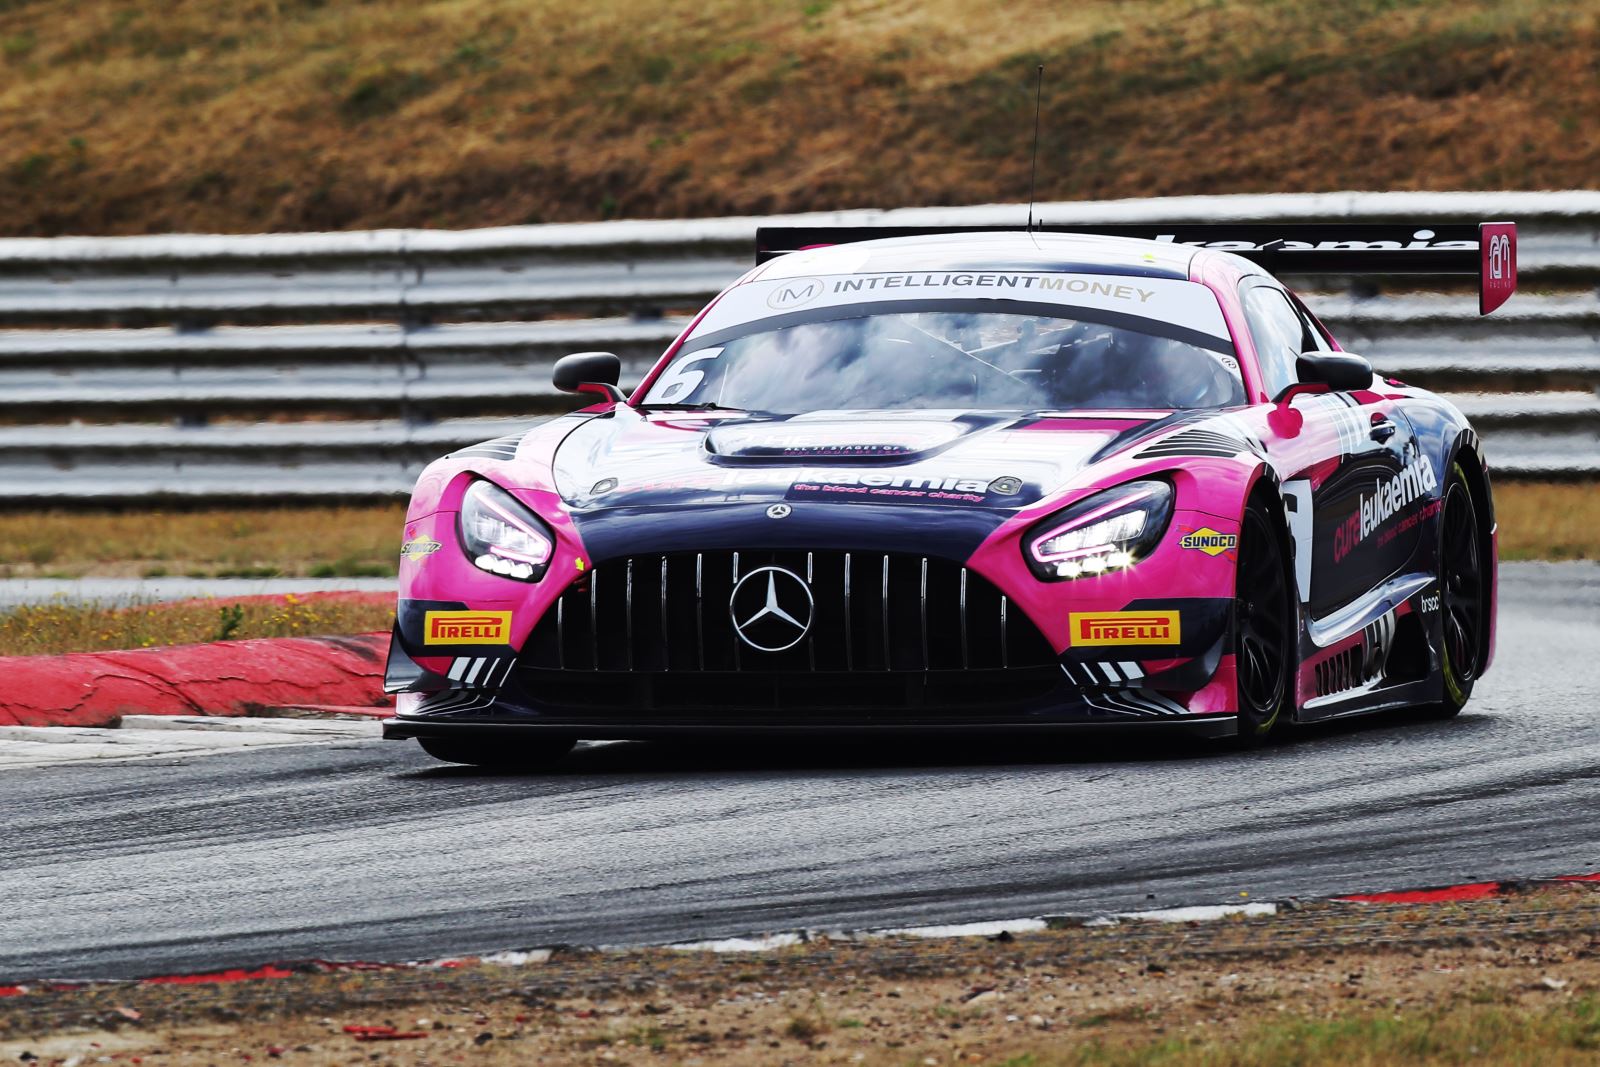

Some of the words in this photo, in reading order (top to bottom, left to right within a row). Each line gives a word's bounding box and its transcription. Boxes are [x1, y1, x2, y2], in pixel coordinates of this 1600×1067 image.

[833, 274, 1156, 304] INTELLIGENTMONEY
[642, 347, 725, 405] 6
[793, 483, 820, 491] the
[822, 484, 867, 494] blood
[869, 487, 927, 497] cancer
[928, 489, 986, 503] charity
[1183, 535, 1236, 548] SUNOCO
[431, 617, 503, 639] PIRELLI
[1080, 617, 1170, 640] PIRELLI
